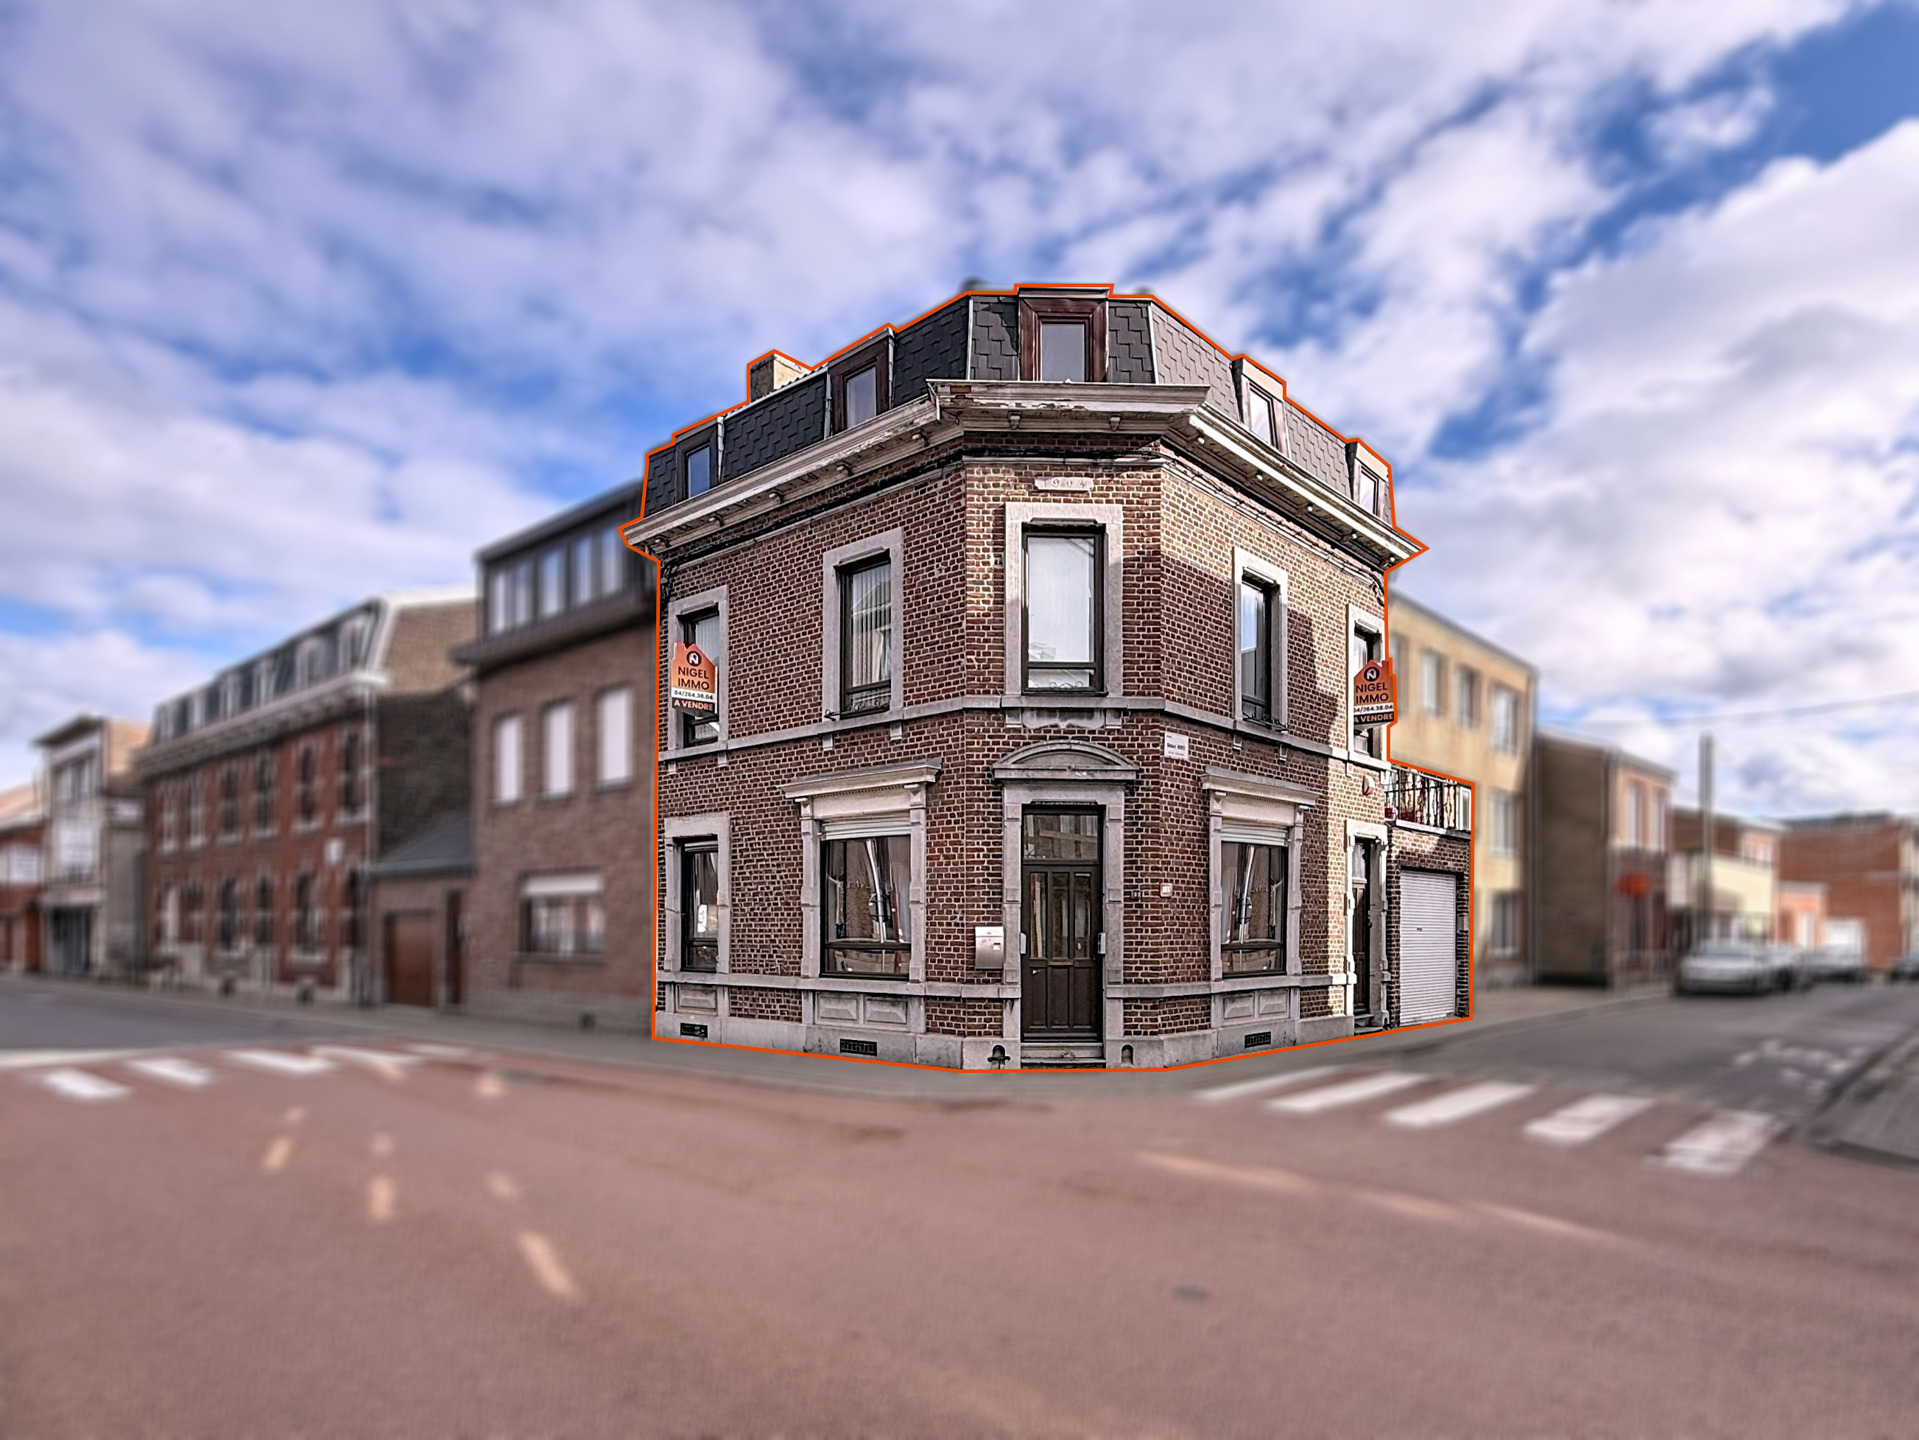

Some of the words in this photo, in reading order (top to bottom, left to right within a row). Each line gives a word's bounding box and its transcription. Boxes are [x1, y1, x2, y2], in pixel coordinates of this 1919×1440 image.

[1042, 478, 1086, 489] 1904
[678, 666, 709, 680] NIGEL
[677, 678, 710, 690] IMMO
[1355, 682, 1388, 693] NIGEL
[1356, 693, 1389, 704] IMMO
[674, 699, 680, 707] A
[681, 700, 713, 711] VENDRE
[1360, 713, 1394, 723] VENDRE
